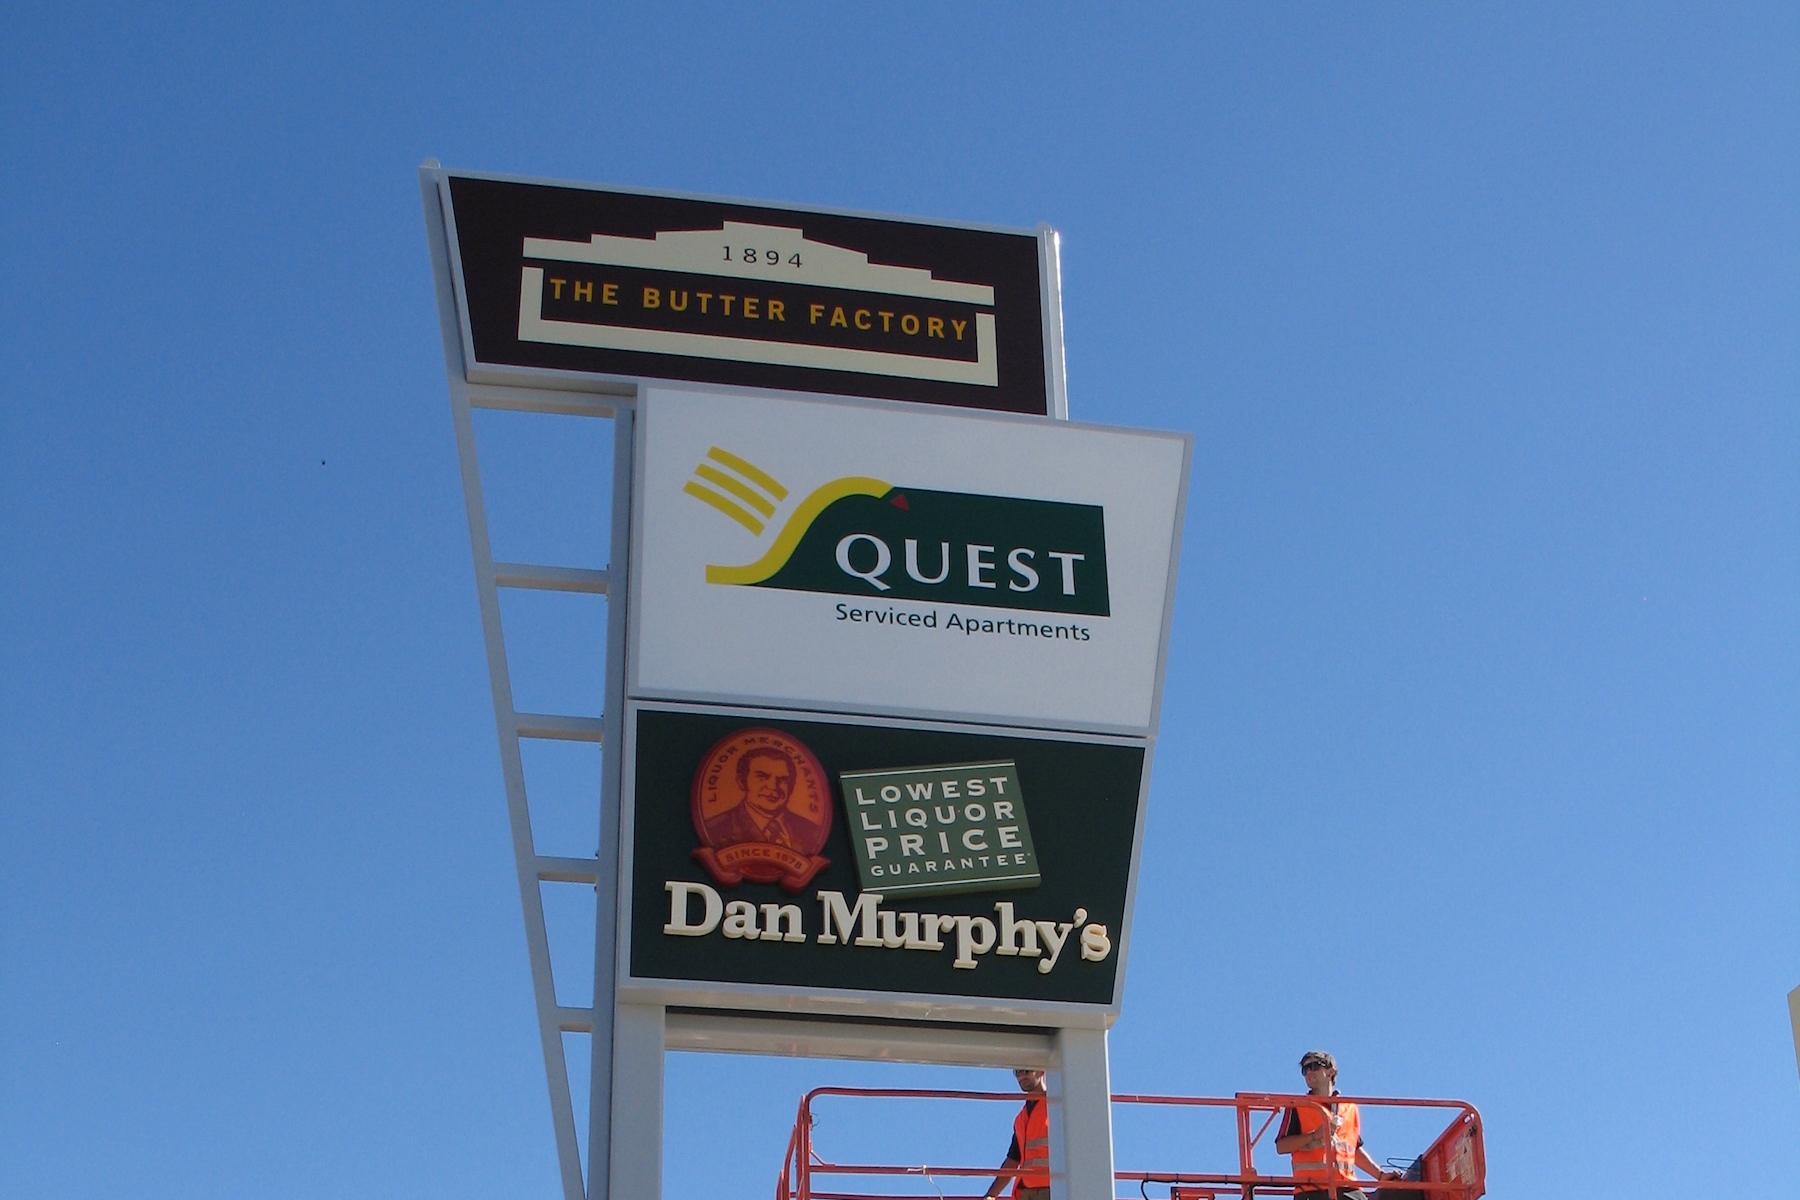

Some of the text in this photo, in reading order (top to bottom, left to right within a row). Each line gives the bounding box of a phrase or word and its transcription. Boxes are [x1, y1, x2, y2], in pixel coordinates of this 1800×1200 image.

[722, 245, 804, 269] 1894
[549, 278, 970, 341] THE BUTTER FACTORY
[834, 533, 1086, 597] QUEST
[836, 603, 1091, 642] Serviced Apartments
[708, 736, 820, 814] LIQUOR MERCHANTS
[855, 775, 1010, 806] LOWEST
[860, 801, 1016, 831] LIQUOR
[725, 848, 771, 862] SINCE
[865, 825, 1023, 860] PRICE
[870, 852, 1027, 878] GUARANTEE
[663, 880, 1112, 974] Dan Murphy's
